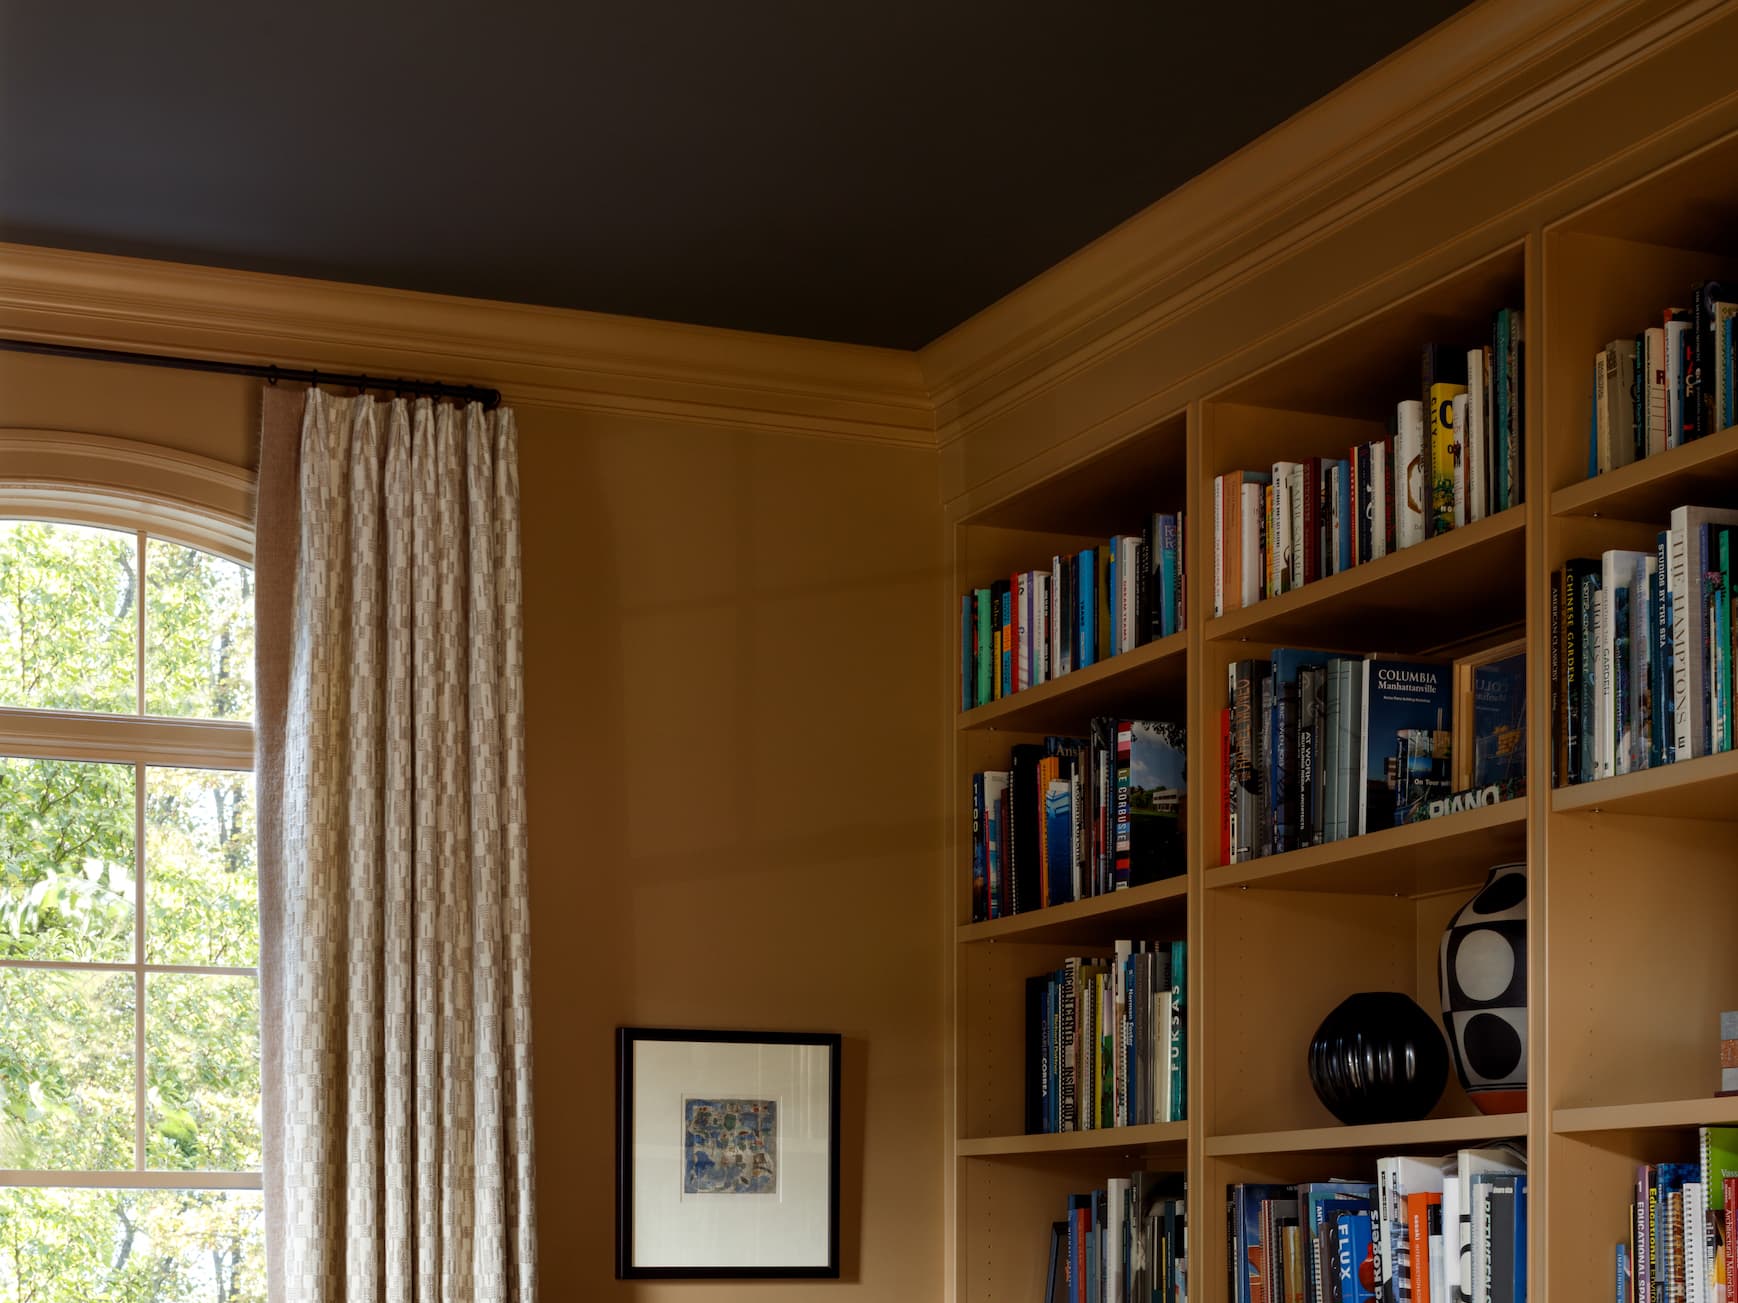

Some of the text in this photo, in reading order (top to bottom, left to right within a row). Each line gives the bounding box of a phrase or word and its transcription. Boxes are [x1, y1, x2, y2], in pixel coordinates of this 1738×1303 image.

[1657, 544, 1665, 586] STUDIOS
[1566, 574, 1574, 625] CHINESE
[1658, 590, 1665, 602] BY
[1673, 535, 1686, 724] THE HAMPTONS
[1378, 669, 1438, 684] COLUMBIA
[1378, 681, 1437, 694] Manhattanville
[1305, 731, 1311, 745] AT
[1118, 769, 1127, 782] LE
[1429, 784, 1500, 819] PIANO
[1064, 961, 1074, 1123] LINCOLN CENTER INSIDE OUT
[1171, 985, 1180, 1072] FUKSAS
[1370, 1209, 1382, 1284] Rogers
[1637, 1201, 1645, 1276] EDUCATIONAL
[1649, 1188, 1657, 1265] Educational
[1725, 1209, 1734, 1258] Architectural
[1337, 1223, 1351, 1281] FLUX
[1726, 1260, 1734, 1298] Materials
